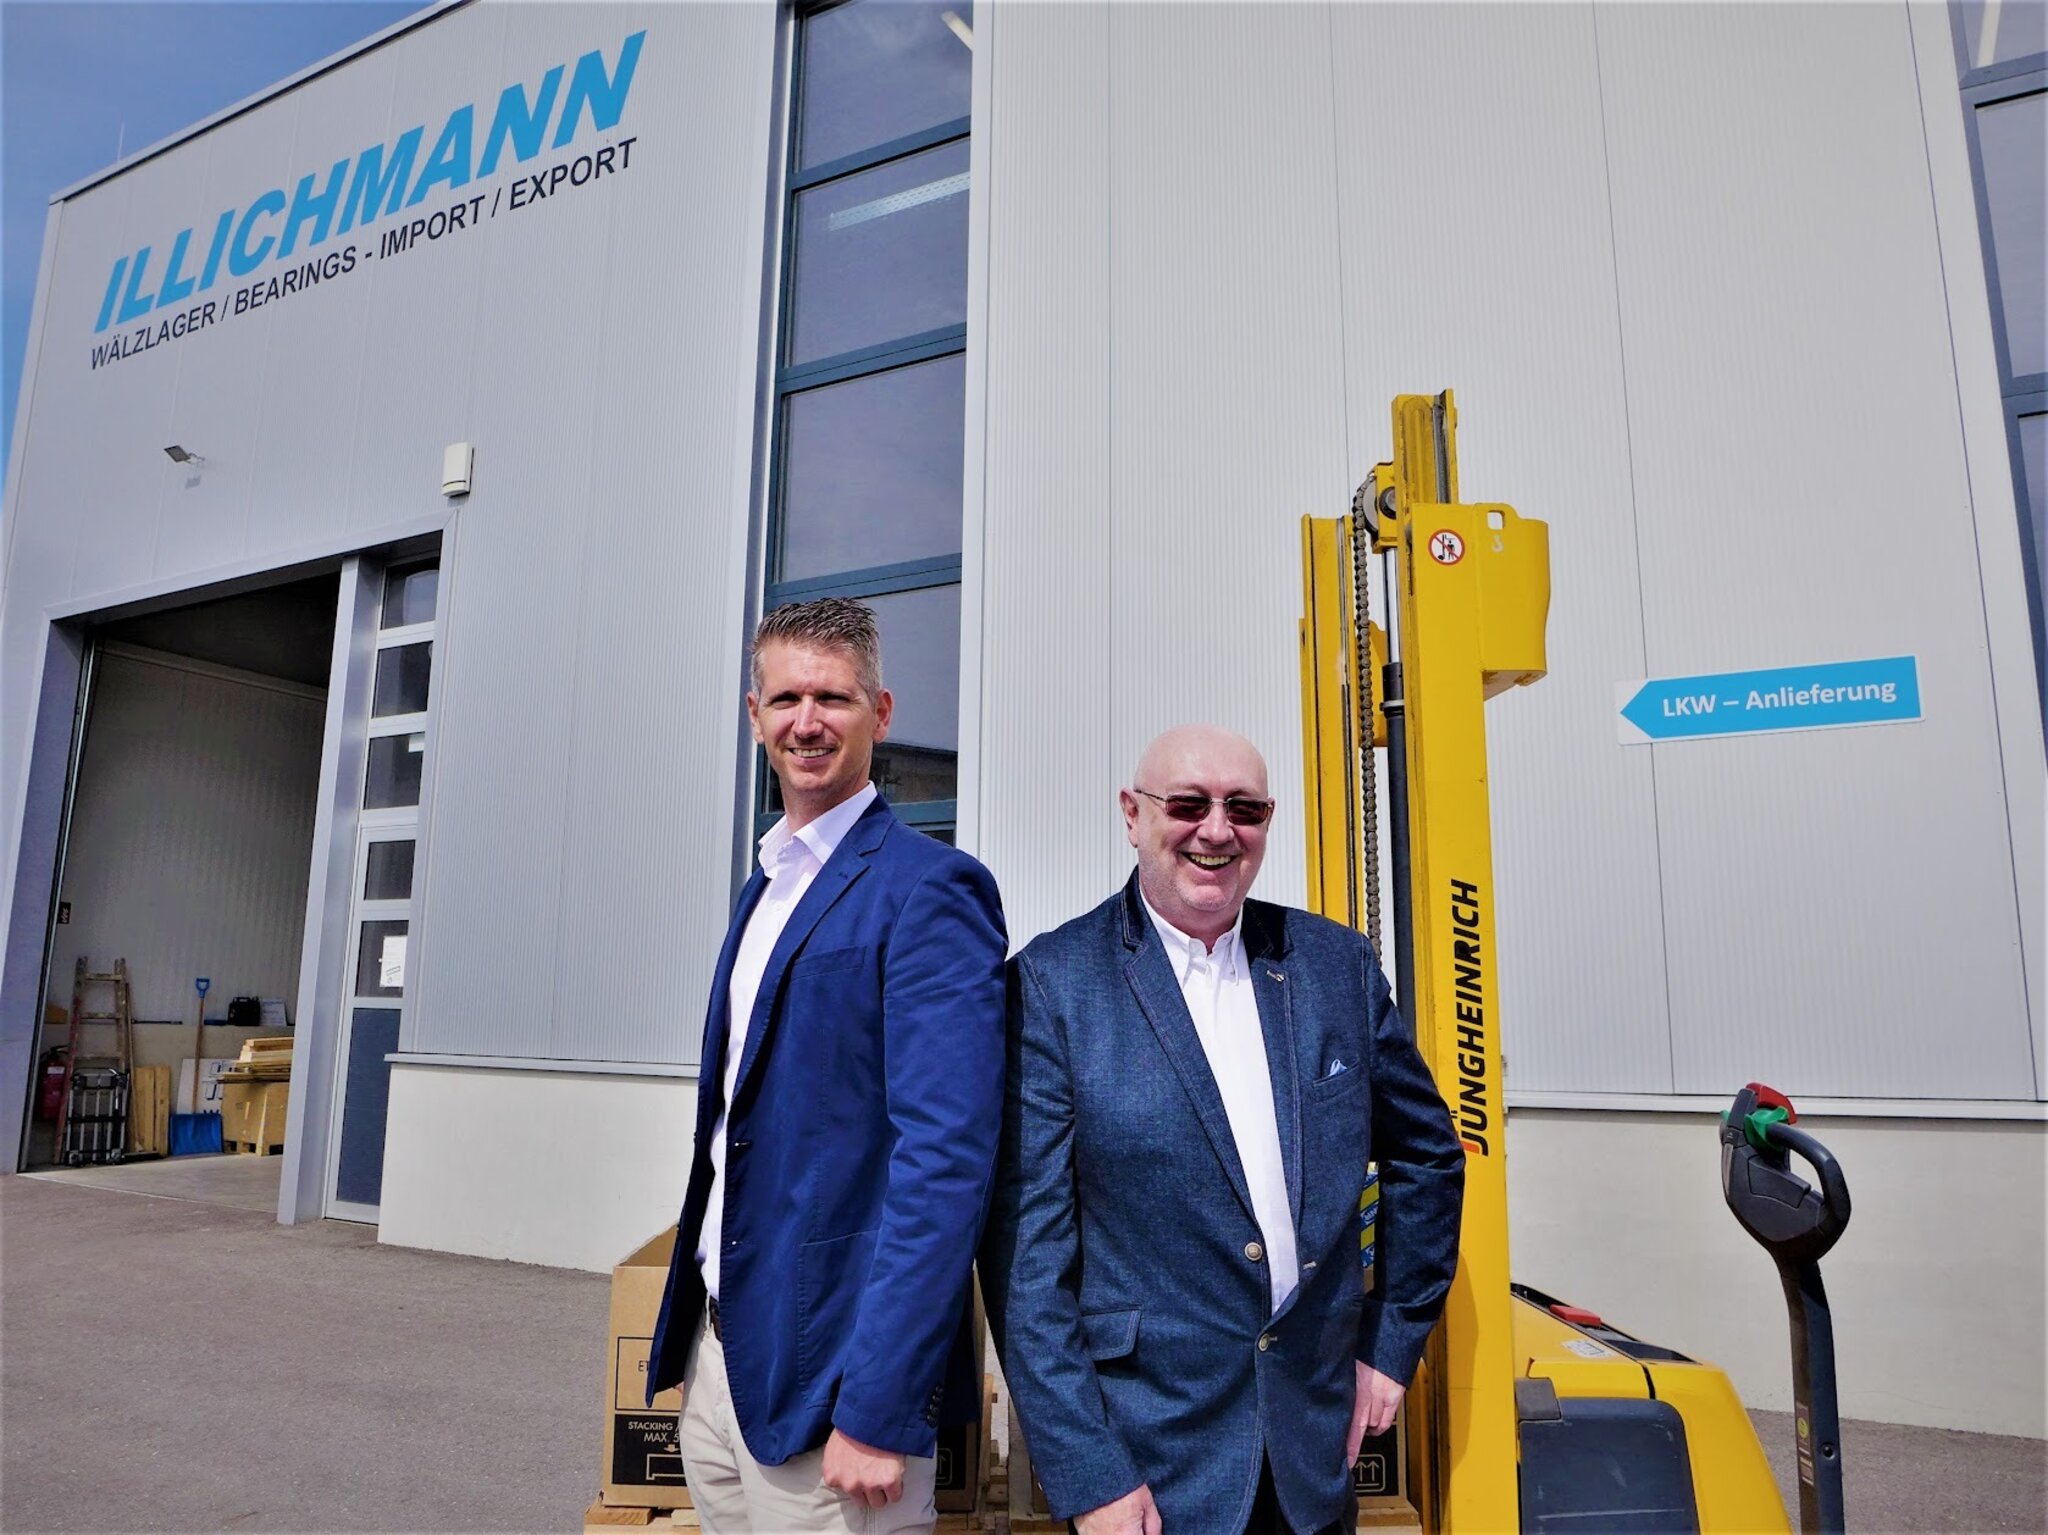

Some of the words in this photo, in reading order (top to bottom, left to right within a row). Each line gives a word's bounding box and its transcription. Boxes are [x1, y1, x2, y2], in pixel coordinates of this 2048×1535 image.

[93, 30, 647, 334] ILLICHMANN
[91, 300, 216, 371] WÄLZLAGER
[220, 294, 230, 322] /
[233, 245, 357, 317] BEARINGS
[380, 195, 485, 262] IMPORT
[491, 187, 502, 218] /
[509, 137, 637, 211] EXPORT
[1662, 695, 1715, 717] LKW
[1745, 682, 1897, 710] Anlieferung
[628, 1421, 674, 1430] STACKING
